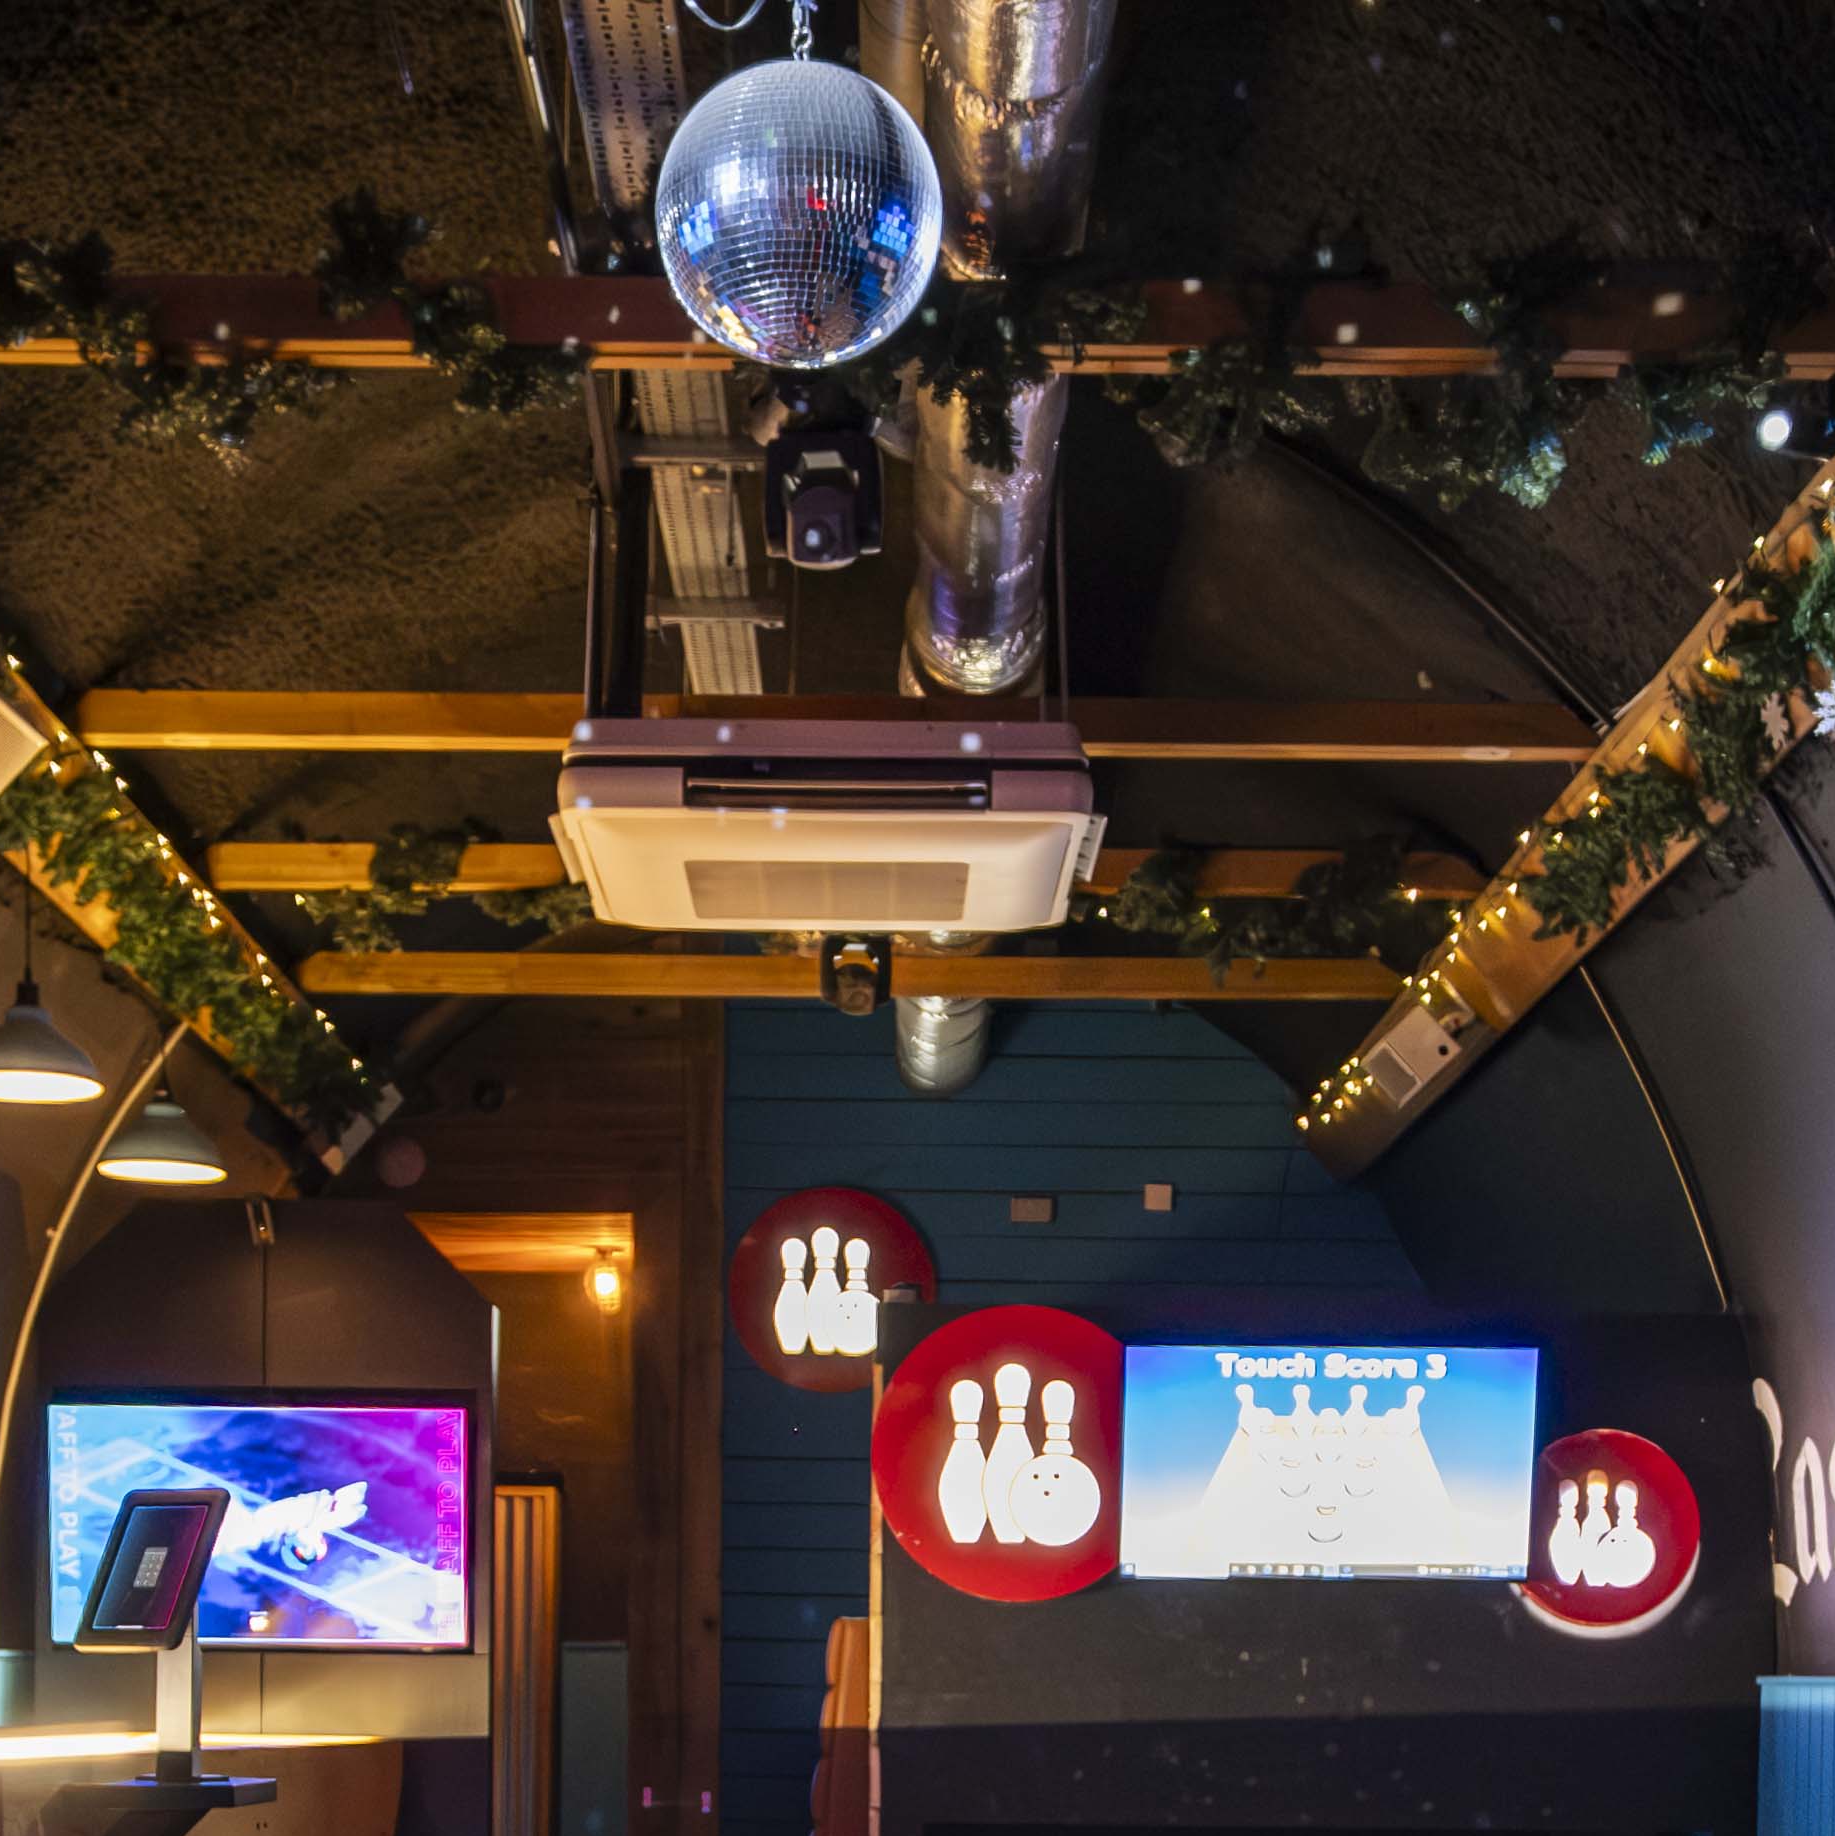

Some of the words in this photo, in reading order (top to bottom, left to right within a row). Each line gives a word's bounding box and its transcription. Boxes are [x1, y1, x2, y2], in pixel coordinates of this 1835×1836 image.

[1215, 1352, 1316, 1379] Touch
[1324, 1353, 1418, 1379] Score
[1425, 1353, 1448, 1379] 3
[437, 1411, 460, 1473] PLAY
[437, 1481, 460, 1519] TO
[58, 1511, 81, 1579] PLAY
